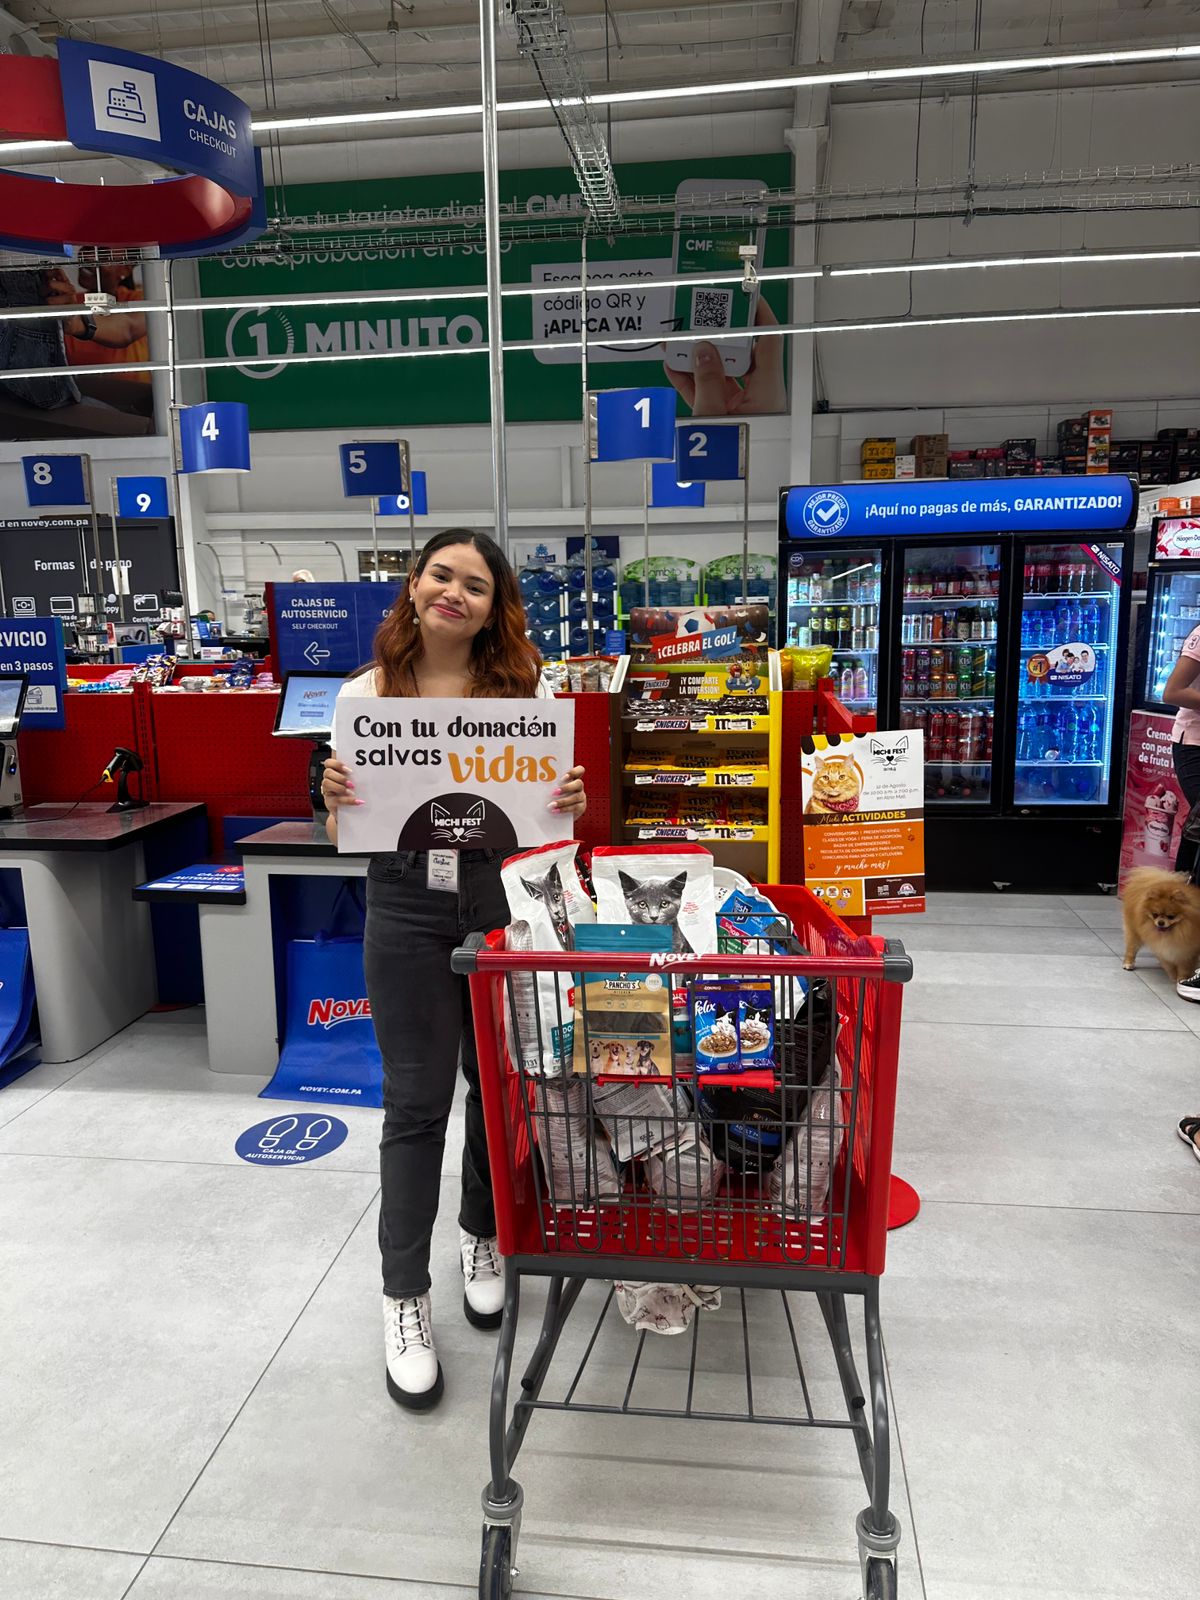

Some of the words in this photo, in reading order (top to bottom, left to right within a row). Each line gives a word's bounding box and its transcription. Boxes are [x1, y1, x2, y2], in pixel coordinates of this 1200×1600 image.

[183, 99, 237, 140] CAJAS
[189, 128, 237, 158] CHECKOUT
[606, 292, 632, 308] QR
[636, 295, 646, 311] y
[304, 314, 484, 353] MINUTO
[544, 318, 610, 338] ¡APLCA
[614, 315, 642, 332] YA!
[247, 322, 269, 356] 1
[634, 398, 650, 428] 1
[201, 412, 219, 441] 4
[688, 432, 708, 457] 2
[349, 450, 367, 474] 5
[33, 462, 53, 485] 8
[136, 493, 151, 512] 9
[807, 493, 827, 509] MEJOR
[827, 493, 847, 510] PRECIO
[865, 503, 899, 518] ¡Aquí
[901, 505, 917, 515] no
[919, 503, 959, 517] pagas
[961, 501, 977, 513] de
[980, 499, 1011, 513] más,
[1014, 495, 1122, 511] GARANTIZADO!
[21, 518, 89, 529] novey.com.pa
[808, 516, 845, 535] GARANTIZADO
[34, 559, 75, 571] Formas
[1096, 550, 1121, 575] NISATO
[291, 599, 322, 607] CAJAS
[324, 598, 336, 607] DE
[281, 609, 348, 618] AUTOSERVICIO
[657, 639, 700, 660] ¡CELEBRA
[702, 638, 712, 650] EL
[714, 631, 737, 647] GOL!
[1, 662, 13, 671] en
[15, 660, 21, 671] 3
[24, 662, 54, 673] pasos
[688, 676, 718, 685] COMPARTE
[679, 686, 686, 695] LA
[353, 715, 402, 738] Con
[411, 718, 439, 738] tu
[447, 715, 557, 738] donación
[654, 719, 688, 729] SNICKERS
[1141, 742, 1156, 752] con
[355, 743, 442, 766] salvas
[447, 745, 558, 784] vidas
[1138, 752, 1149, 763] de
[1150, 753, 1169, 767] fruta
[654, 774, 688, 784] SNICKERS
[434, 818, 460, 828] MICHI
[462, 817, 481, 827] FEST
[842, 810, 907, 823] ACTIVIDADES
[655, 828, 688, 837] SNICKERS
[844, 859, 868, 870] mucho
[649, 953, 704, 967] NOVEY
[608, 981, 636, 990] PANCHO'S
[299, 1086, 362, 1095] NOVEY.COM.PA
[245, 1153, 306, 1162] AUTOSERVICIO
